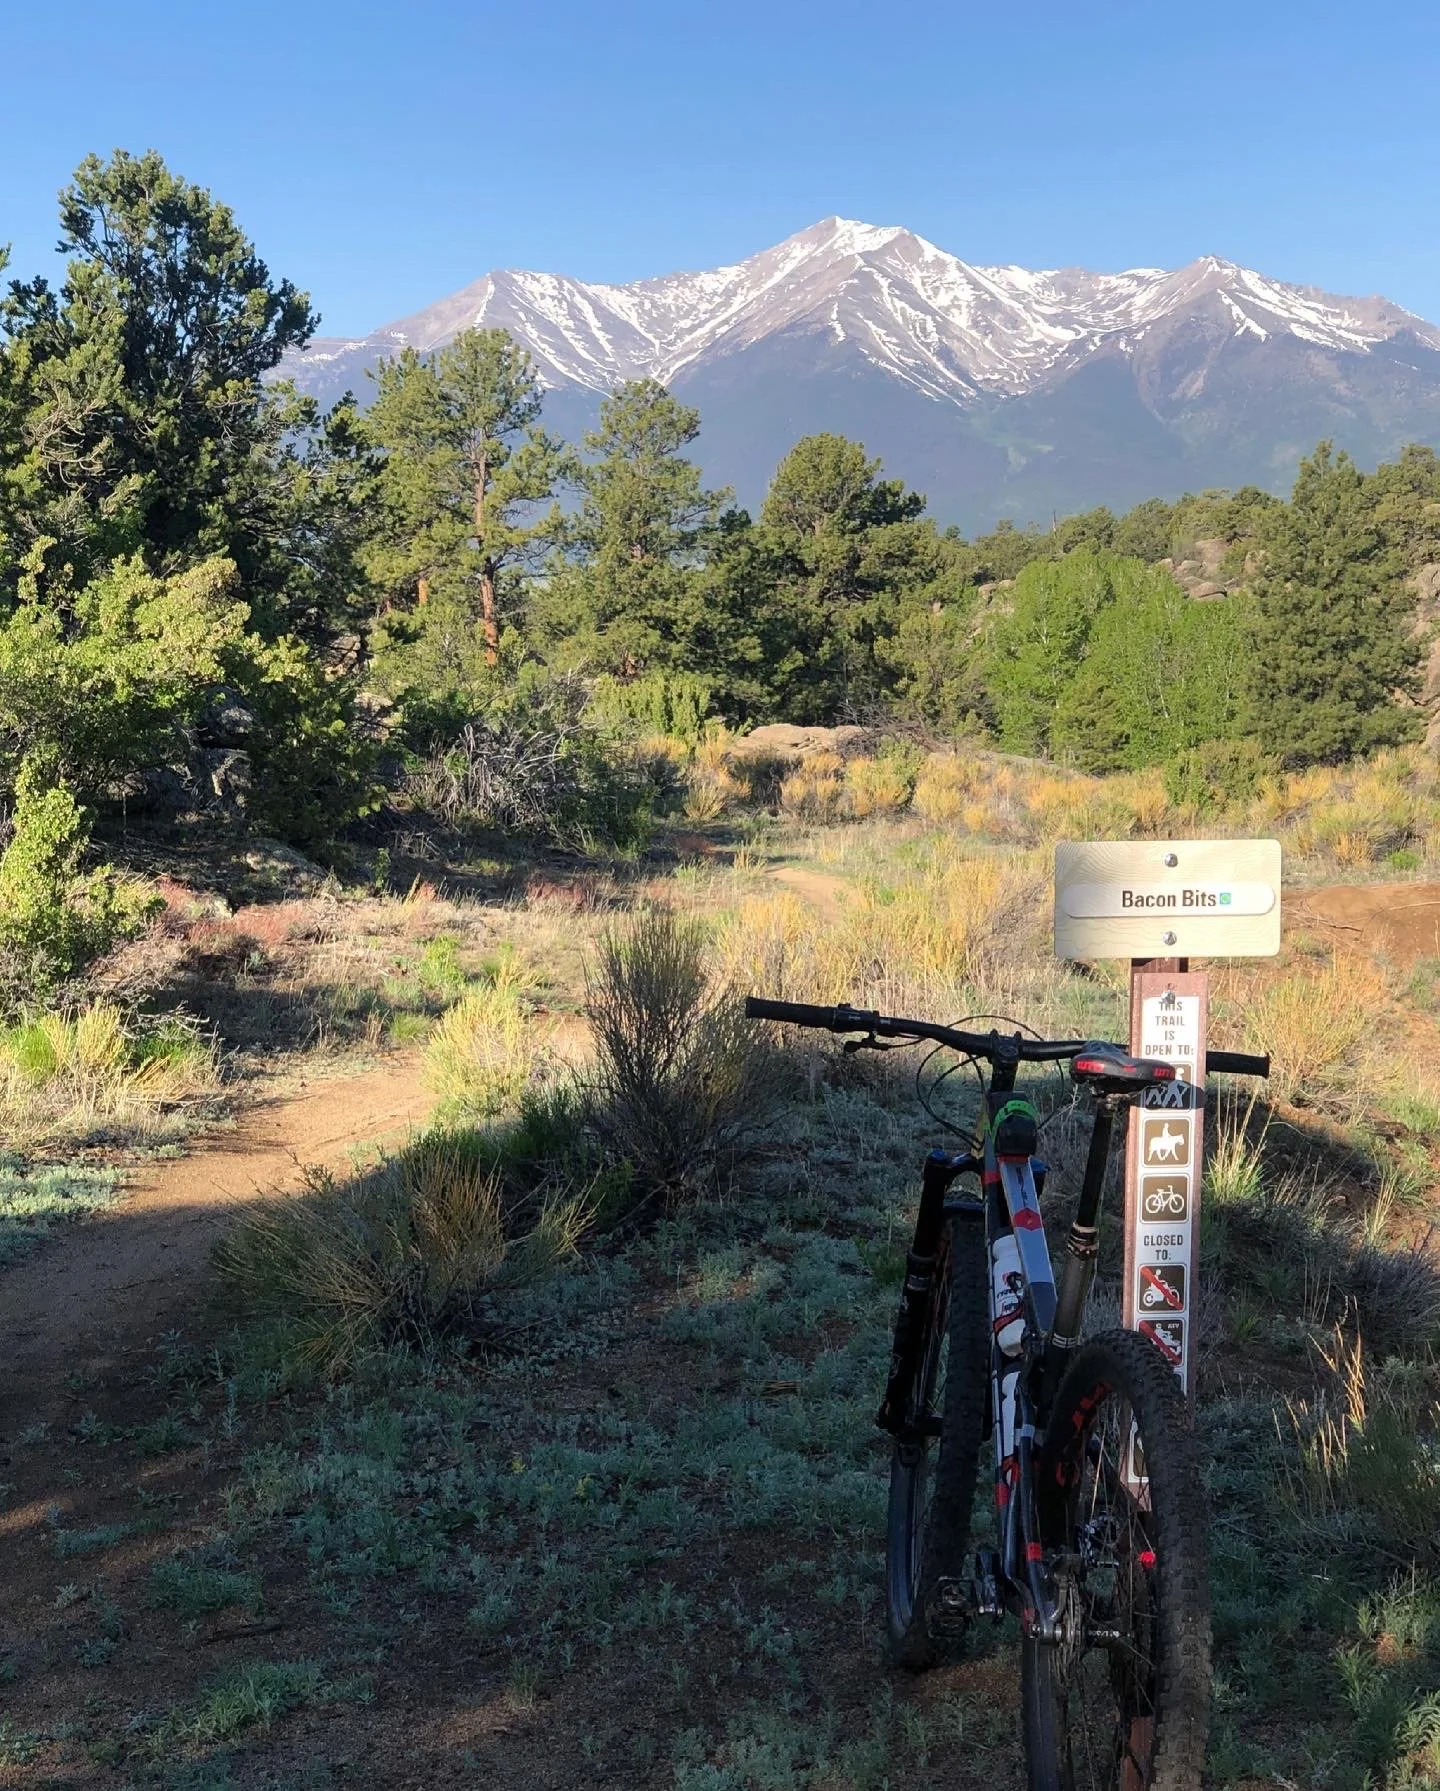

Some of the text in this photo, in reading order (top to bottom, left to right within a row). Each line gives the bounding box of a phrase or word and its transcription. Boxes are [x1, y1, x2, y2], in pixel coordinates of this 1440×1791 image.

[1122, 889, 1216, 908] Bacon Bits
[1159, 1001, 1183, 1011] THIS
[1155, 1015, 1185, 1026] TRAIL
[1164, 1030, 1175, 1041] IS
[1145, 1044, 1194, 1056] OPEN TO:
[1143, 1234, 1184, 1246] CLOSED
